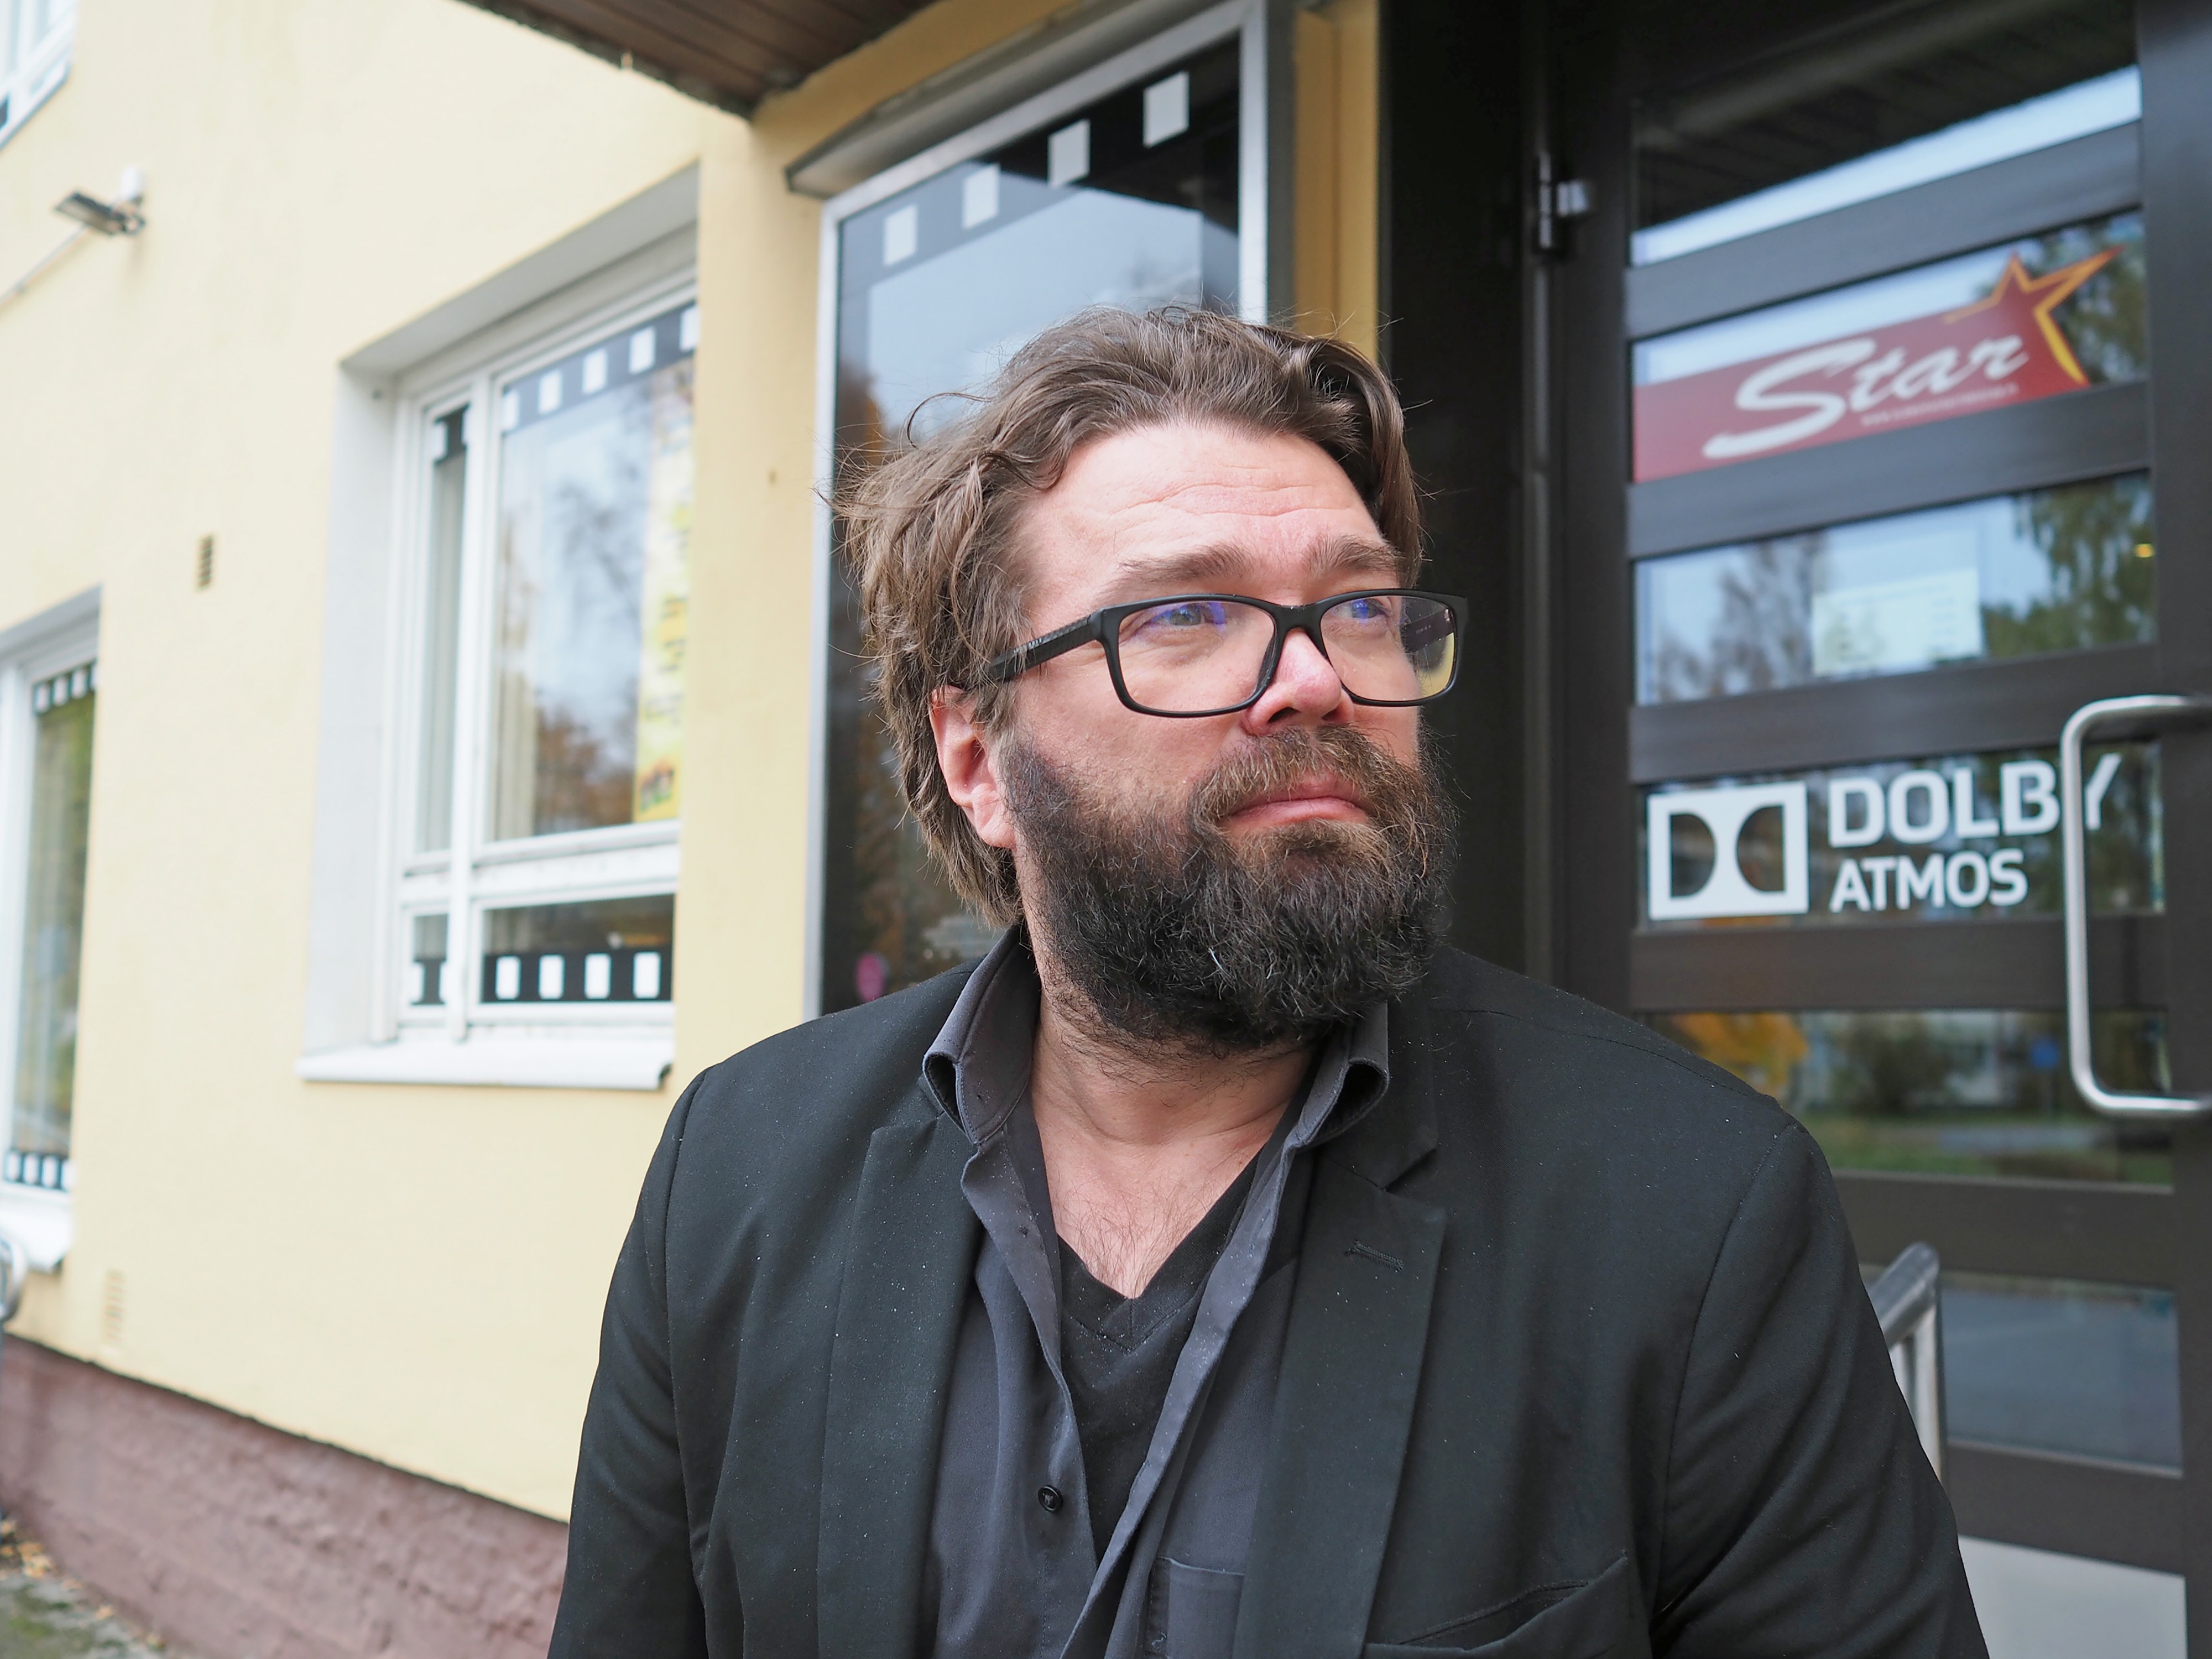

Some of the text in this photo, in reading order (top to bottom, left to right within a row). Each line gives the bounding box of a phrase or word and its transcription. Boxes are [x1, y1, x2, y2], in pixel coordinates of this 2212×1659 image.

[1702, 334, 2029, 458] Star
[1829, 753, 2121, 848] DOLBY
[1829, 848, 2028, 913] ATMOS
